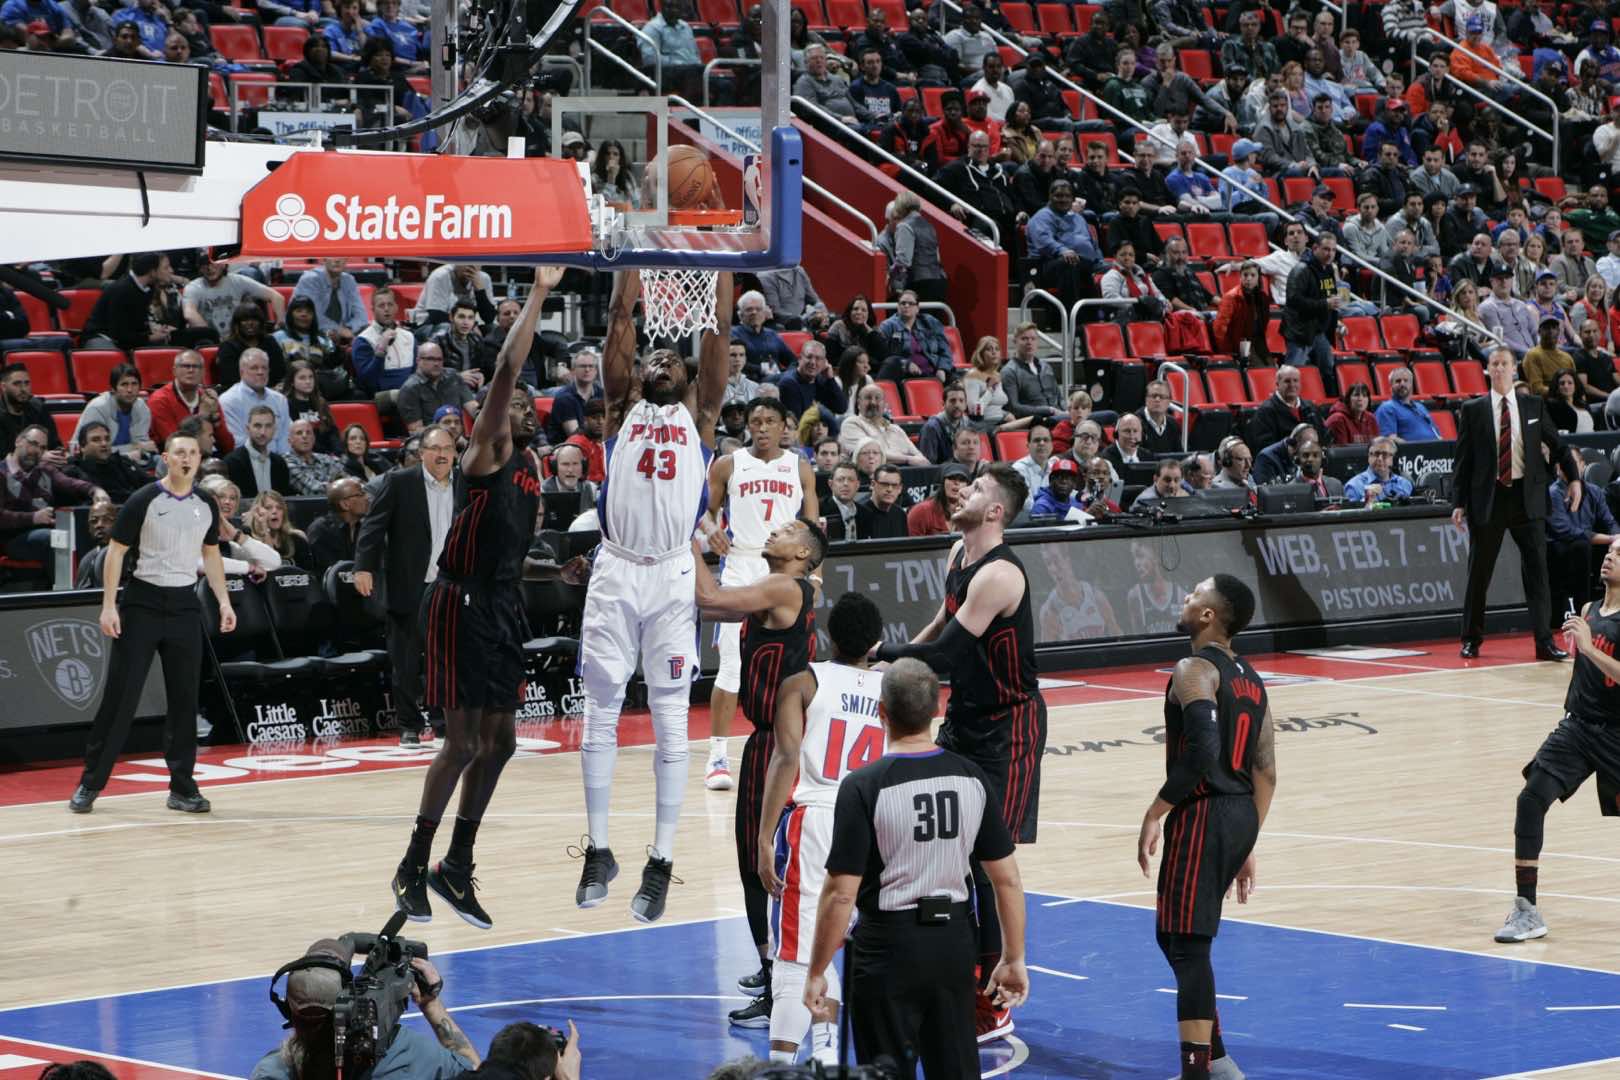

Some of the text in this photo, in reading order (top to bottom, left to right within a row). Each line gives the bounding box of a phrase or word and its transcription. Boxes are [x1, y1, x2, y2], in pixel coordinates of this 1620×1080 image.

[2, 119, 156, 143] BASKETBALL
[629, 423, 688, 446] PSTONS
[637, 447, 677, 481] 43
[1413, 454, 1456, 476] Caesar
[738, 479, 794, 498] PISTONS
[760, 498, 774, 521] 7
[1331, 529, 1391, 571] FEB.
[1390, 527, 1408, 568] 7
[1321, 581, 1454, 611] PISTONS.COM
[31, 624, 102, 664] NETS
[254, 702, 297, 725] Little
[320, 697, 361, 719] Little
[841, 692, 880, 719] SMITH
[246, 722, 307, 743] Caesars
[312, 716, 369, 737] Caesars
[822, 717, 886, 781] 14
[1231, 712, 1250, 772] 0
[912, 790, 959, 843] 30
